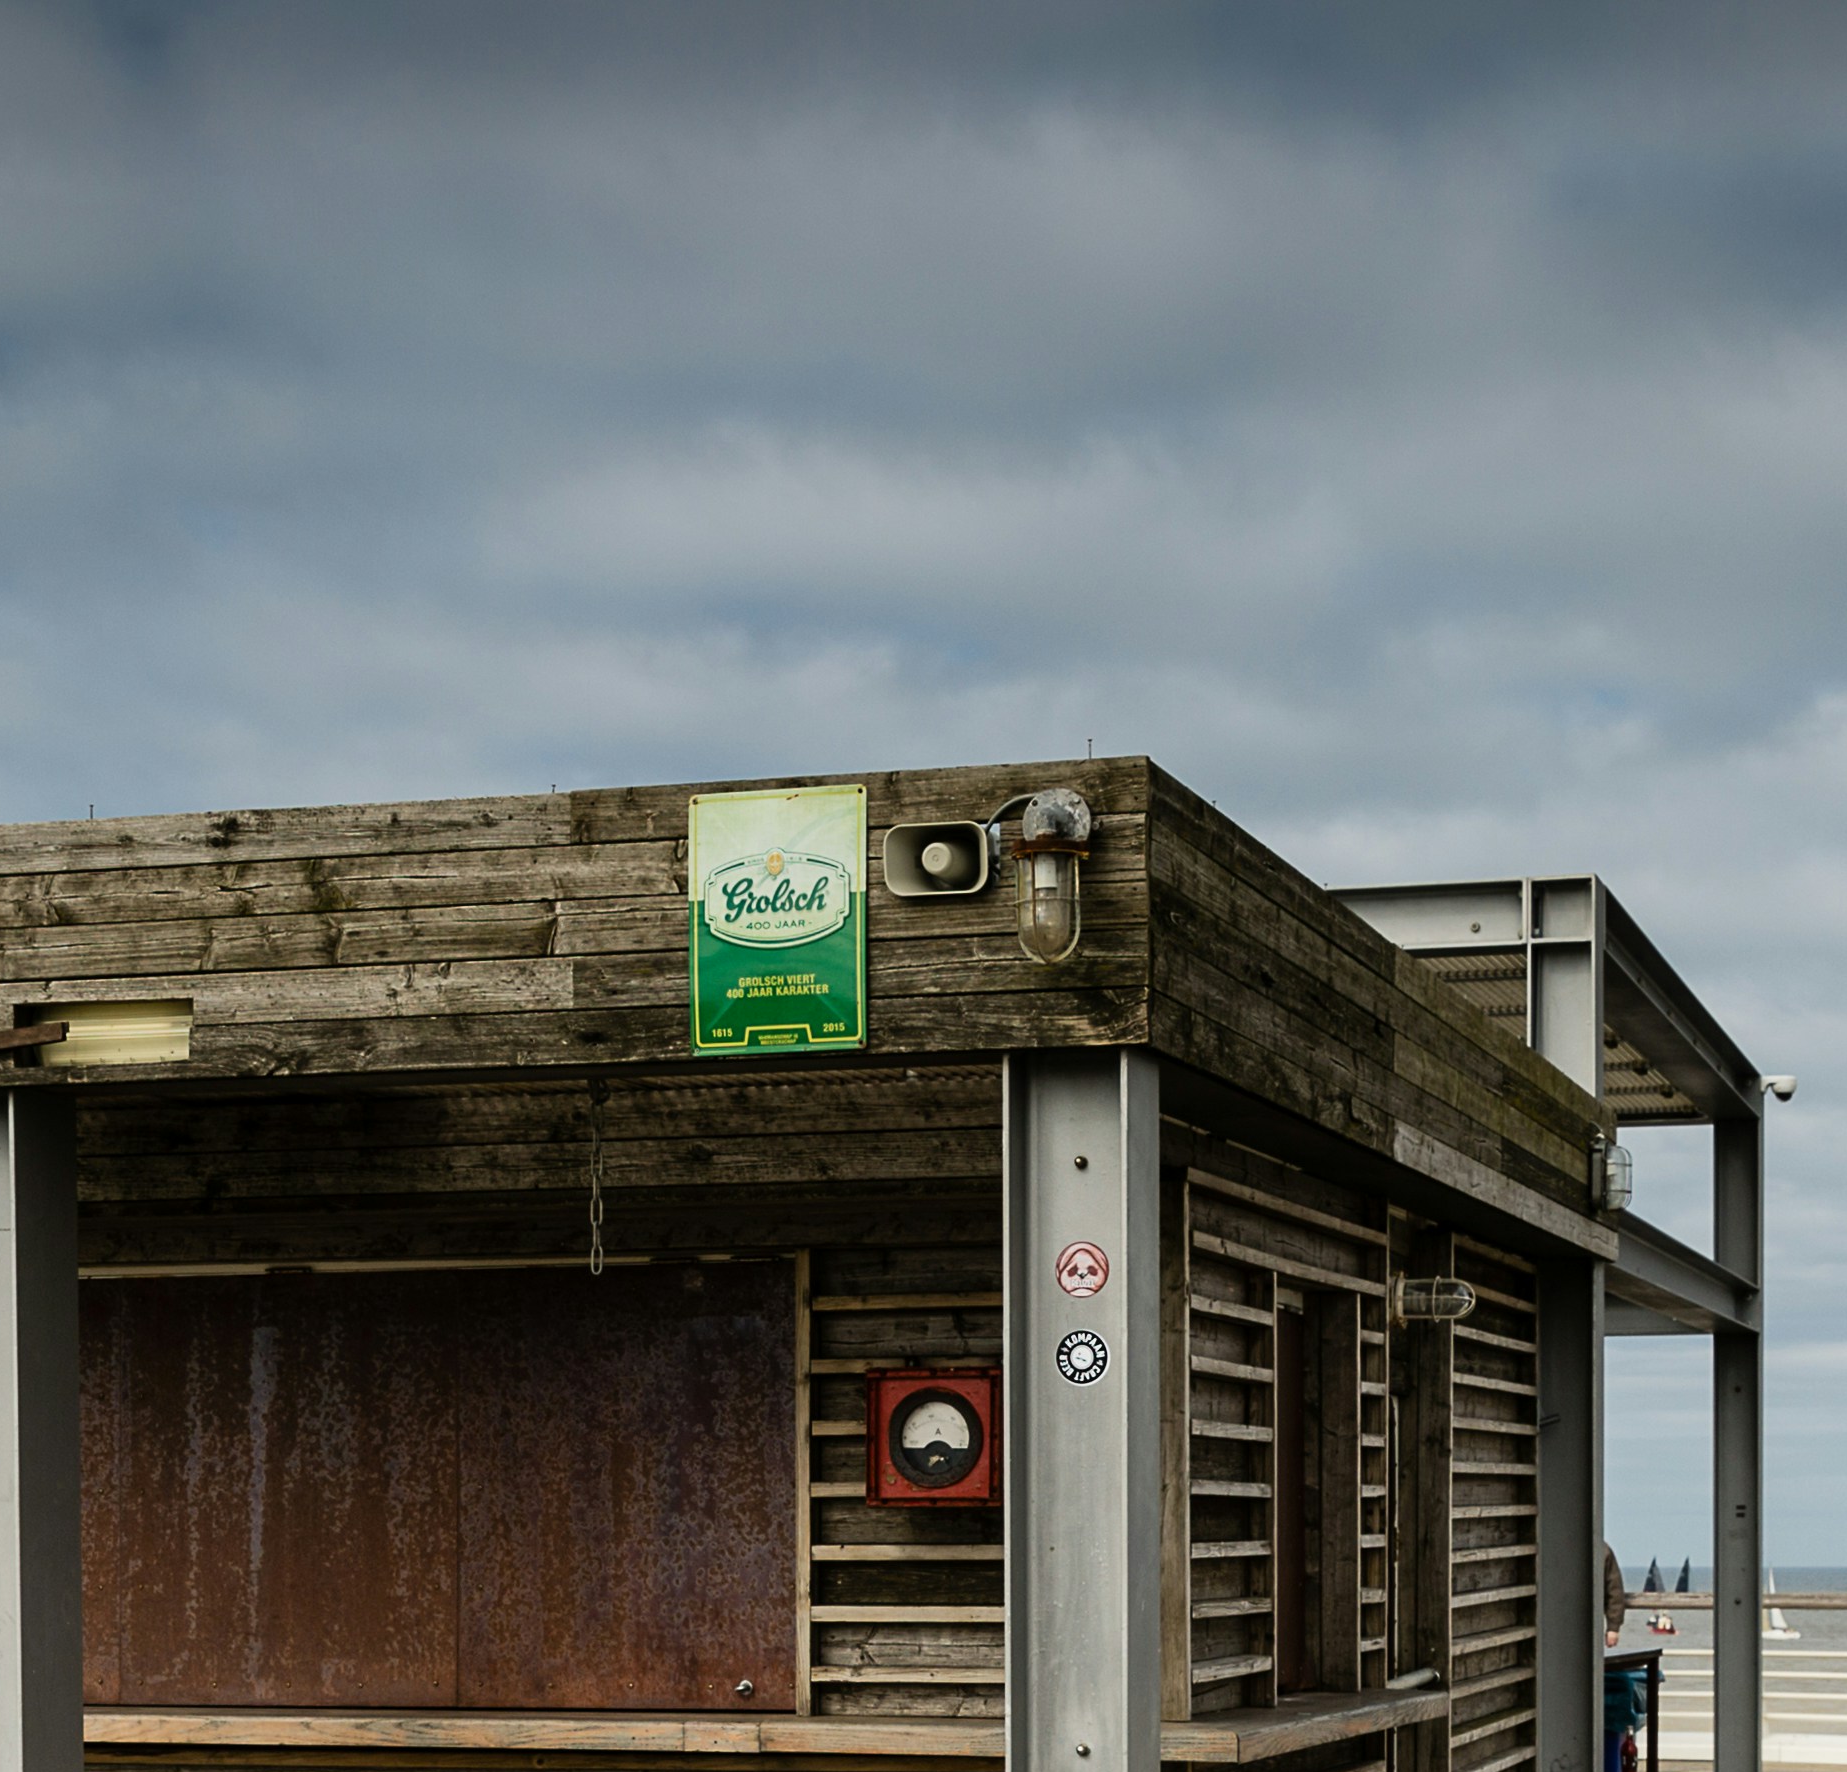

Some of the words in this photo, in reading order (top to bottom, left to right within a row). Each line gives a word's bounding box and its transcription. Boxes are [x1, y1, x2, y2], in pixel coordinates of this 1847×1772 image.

[722, 876, 829, 923] Grolsch
[746, 922, 771, 930] 400
[775, 920, 806, 929] JAAR
[738, 975, 784, 988] GROLSCH
[786, 973, 816, 985] VIERT
[726, 988, 744, 998] 400
[747, 987, 773, 998] JAAR
[776, 984, 829, 996] KARAKTER
[712, 1028, 733, 1037] 1615
[823, 1023, 845, 1032] 2015
[1064, 1332, 1106, 1358] KOMPAAN
[1059, 1354, 1074, 1377] BEER
[1073, 1365, 1101, 1382] CRAFT
[935, 1427, 942, 1435] A
